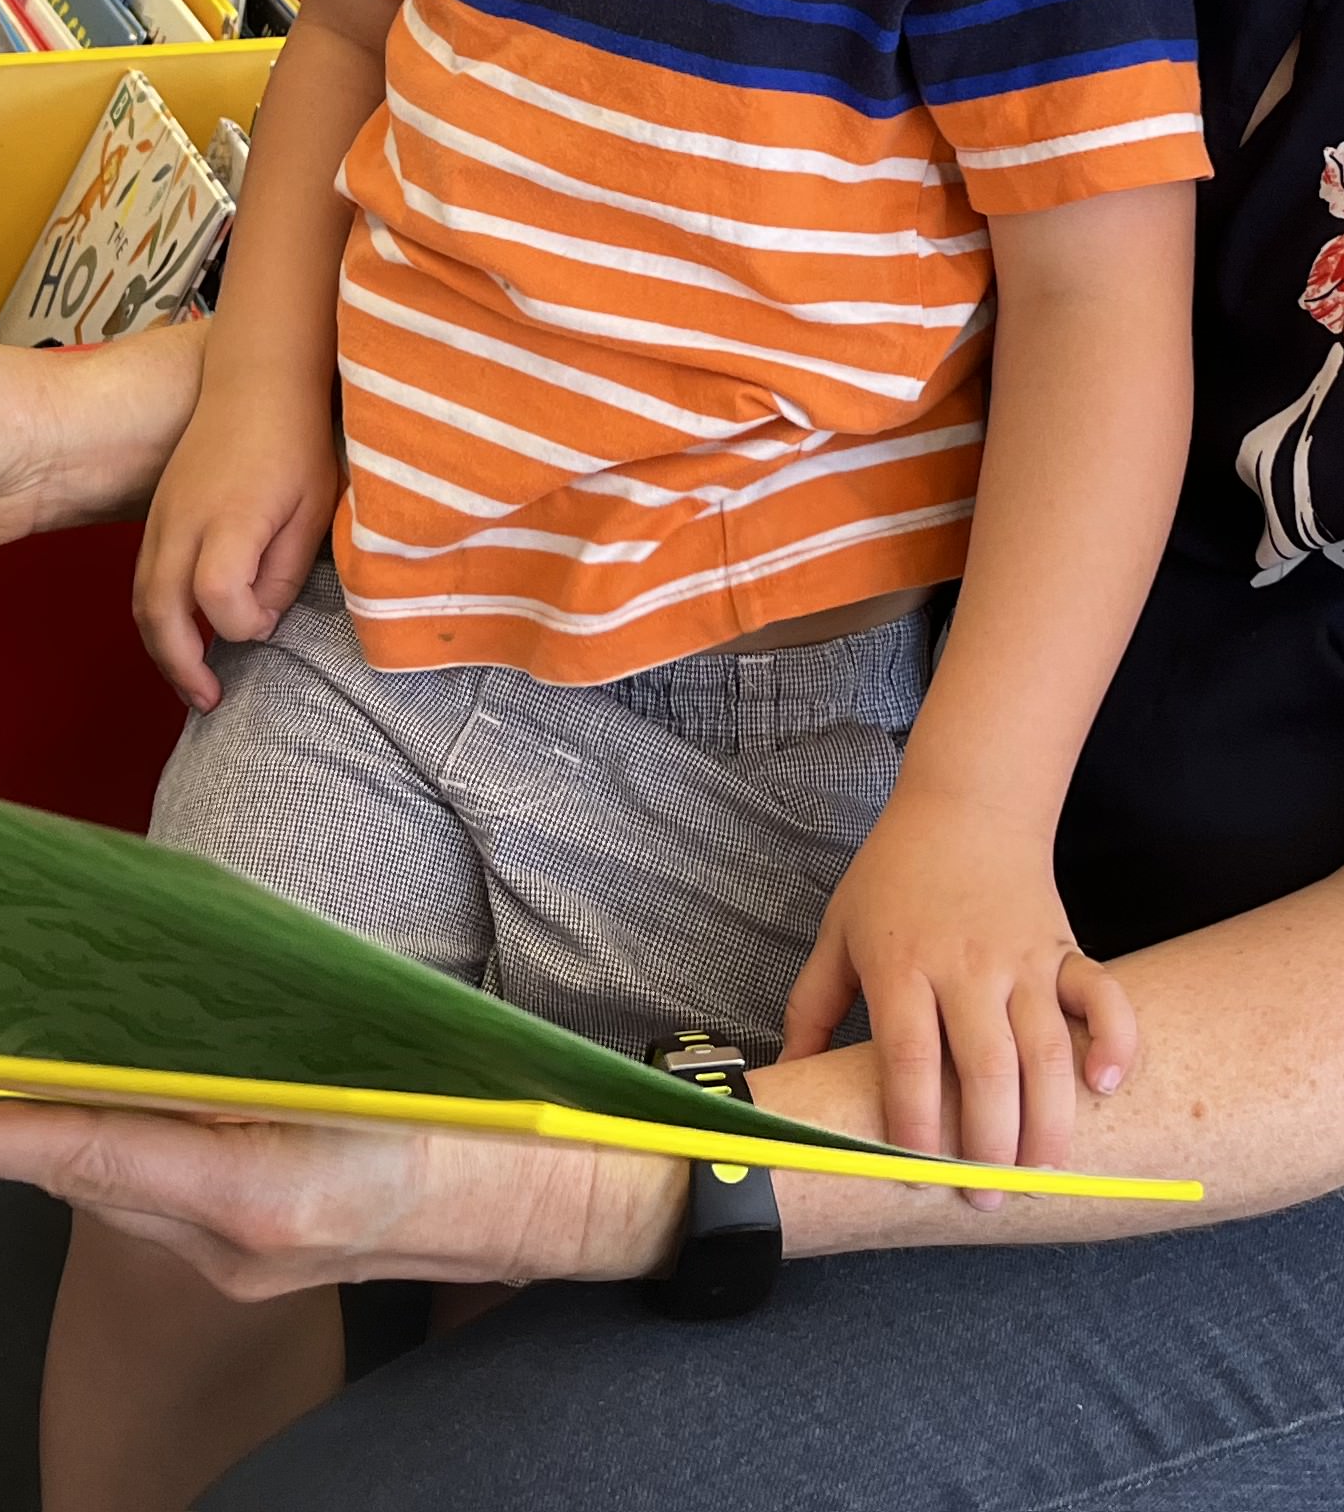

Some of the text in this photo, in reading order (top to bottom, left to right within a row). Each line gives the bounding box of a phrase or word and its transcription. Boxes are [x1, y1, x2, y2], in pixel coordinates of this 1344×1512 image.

[113, 92, 130, 121] B
[107, 221, 129, 261] THE
[29, 235, 114, 345] HOL
